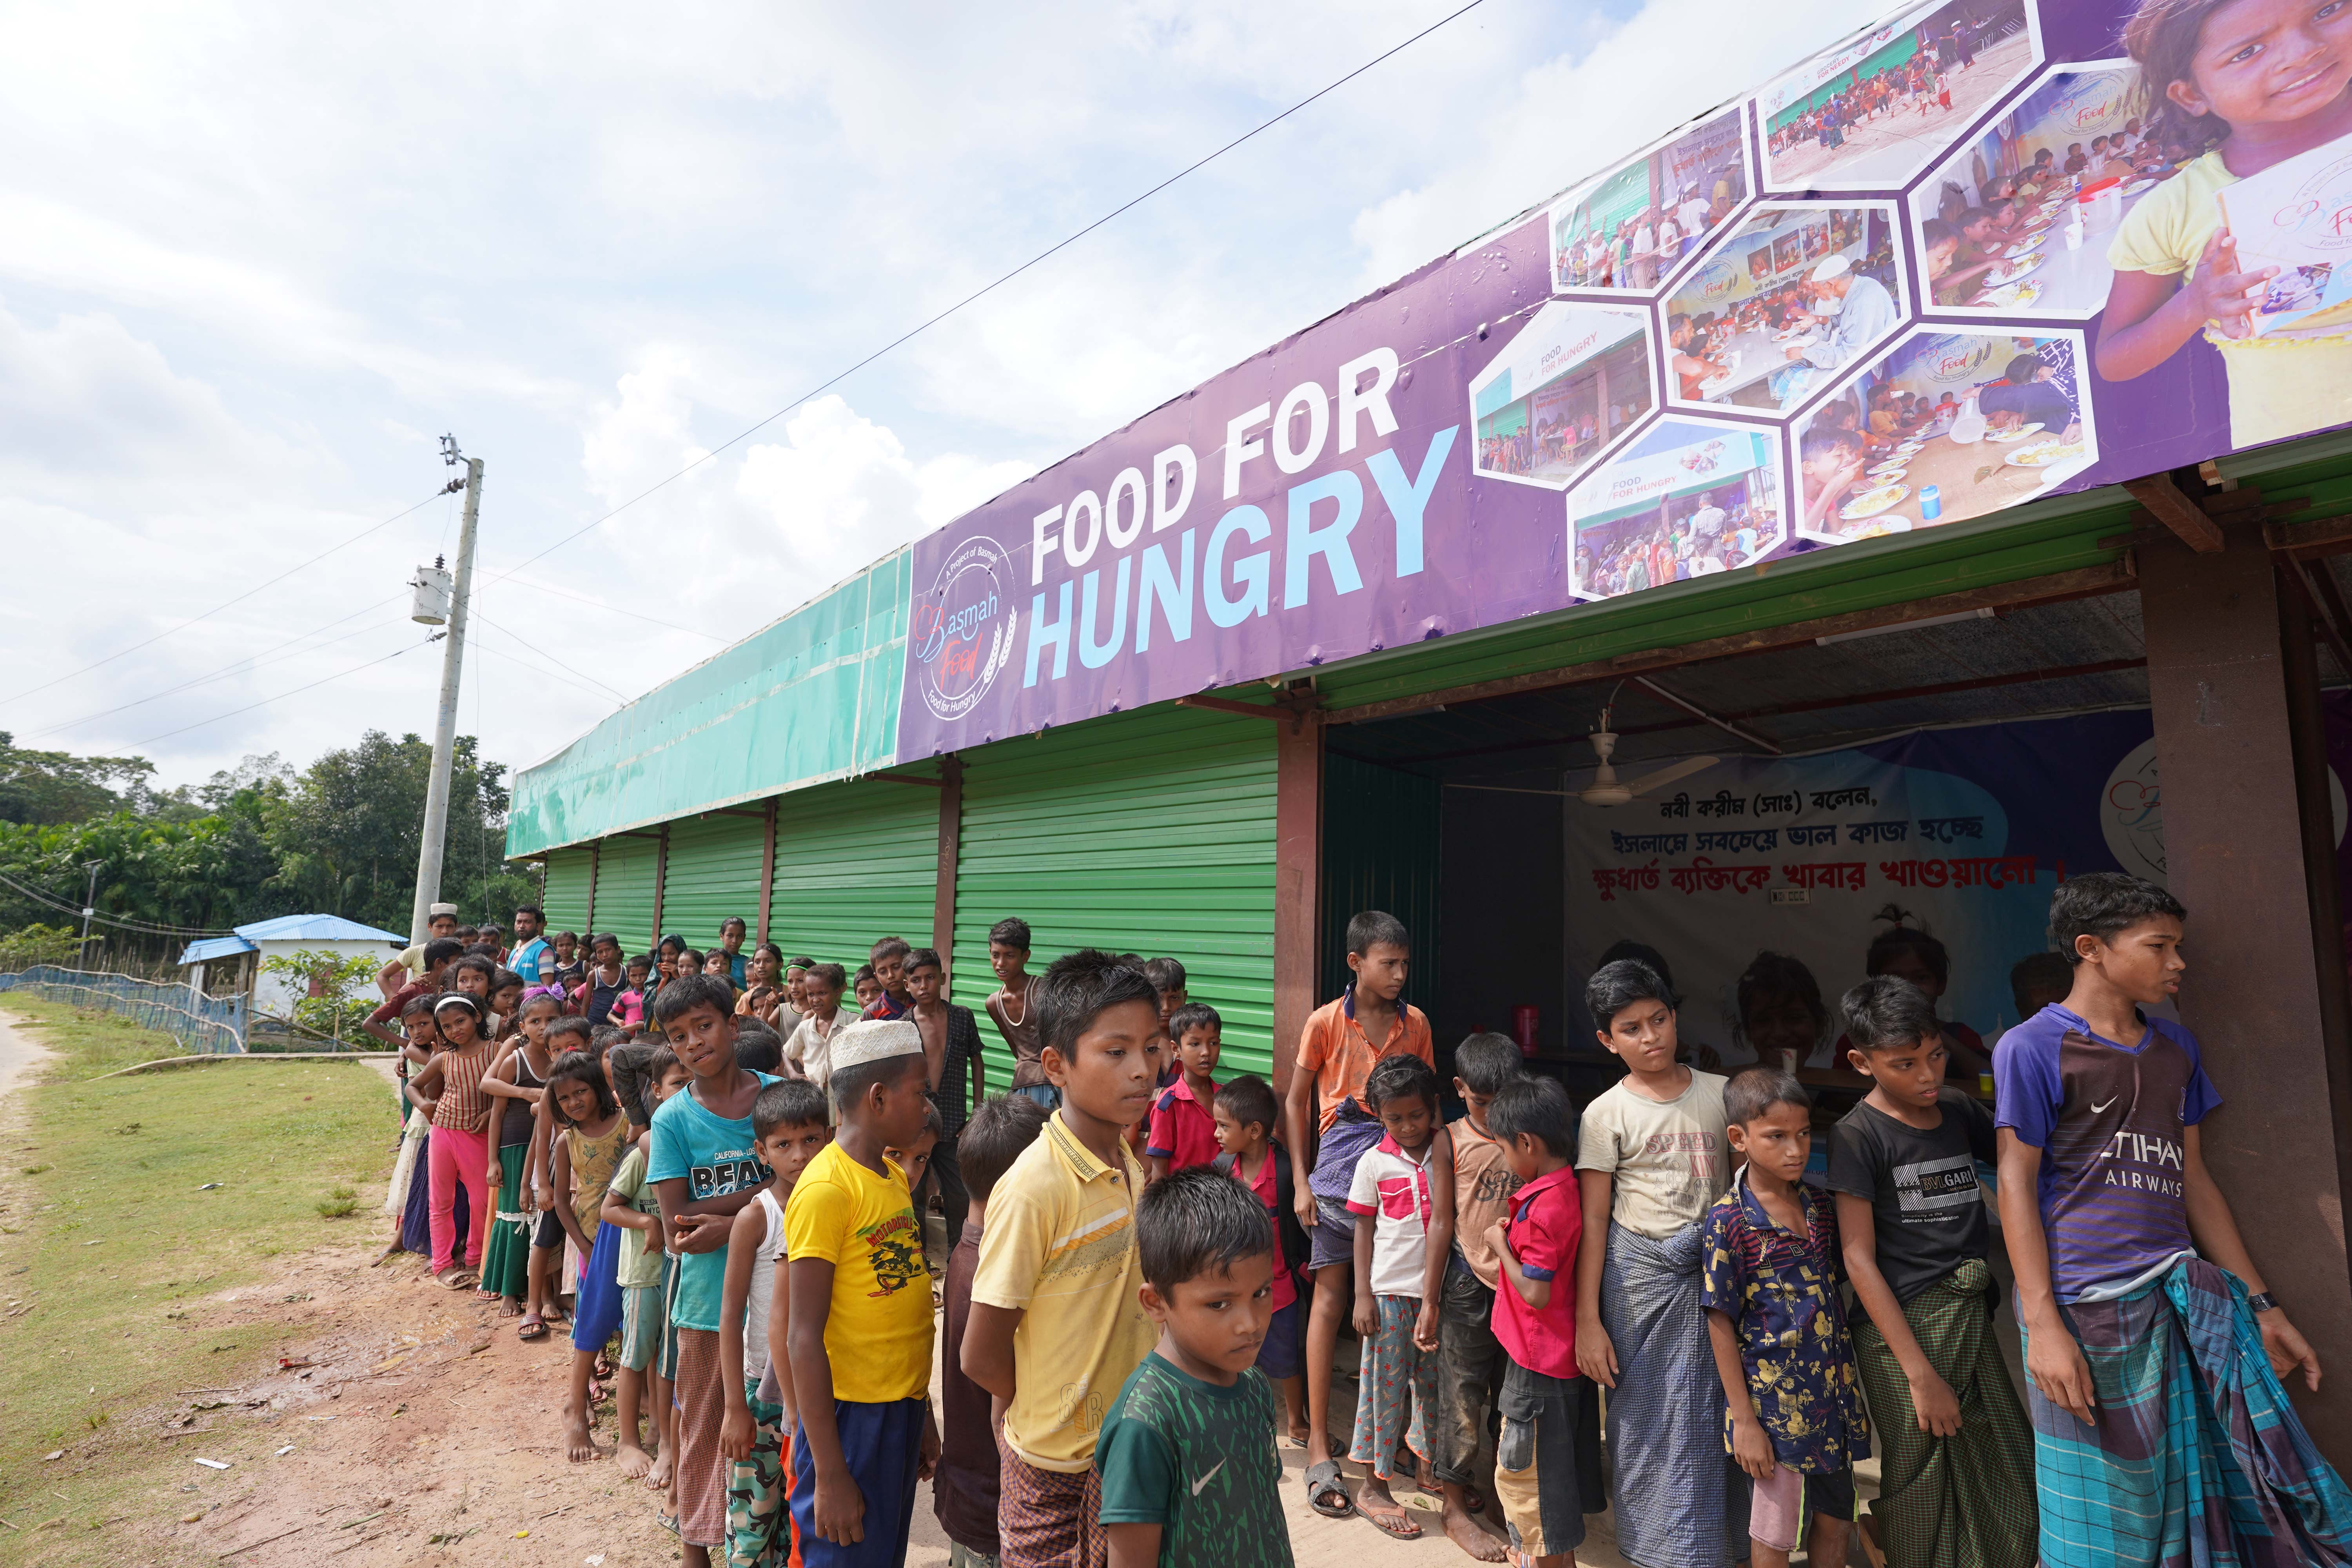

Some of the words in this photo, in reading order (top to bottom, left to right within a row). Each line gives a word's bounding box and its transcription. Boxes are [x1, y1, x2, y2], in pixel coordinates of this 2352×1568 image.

[1817, 56, 1839, 75] GROCERY
[1818, 70, 1829, 80] FOR
[1830, 55, 1850, 72] NEEDY
[2075, 100, 2107, 127] Food
[2089, 120, 2108, 132] Hungry
[2319, 237, 2343, 247] Food
[1541, 345, 1561, 366] FOOD
[1542, 361, 1555, 376] FOR
[1558, 330, 1597, 366] HUNGRY
[1939, 352, 1969, 375] Food
[1952, 370, 1970, 381] Hungry
[1032, 444, 1197, 587] FOOD
[1223, 347, 1399, 500] FOR
[1613, 476, 1641, 490] FOOD
[1613, 488, 1633, 499] FOR
[1637, 475, 1677, 494] HUNGRY
[946, 571, 951, 579] A
[950, 553, 970, 572] Project
[970, 546, 977, 557] of
[978, 546, 998, 564] Basmah
[1023, 424, 1460, 689] HUNGRY
[915, 590, 998, 662] Basmah
[940, 632, 983, 691] Food
[928, 689, 942, 710] Food
[940, 700, 950, 711] for
[950, 691, 976, 712] Hungry
[1661, 794, 1689, 818] নবী
[1697, 791, 1745, 817] করীম
[1753, 791, 1802, 817] (সাঃ)
[1612, 830, 1687, 855] ইসলামে
[1696, 828, 1778, 853] সবচেয়ে
[1787, 824, 1836, 847] ভাল
[1849, 820, 1907, 844] কাজ
[1919, 815, 1984, 841] হচ্ছে
[1592, 860, 1659, 901] ক্ষুধার্ত
[1670, 856, 1771, 896] ব্যক্তিকে
[1782, 863, 1866, 892] খাবার
[1882, 855, 2036, 889] খাওয়ানো
[1646, 1132, 1718, 1154] SPEED
[1920, 1170, 1973, 1191] BVLGARI
[2105, 1169, 2182, 1198] AIRWAYS
[865, 1215, 913, 1247] MOTORCYCLE
[1924, 1215, 1959, 1223] sophistication
